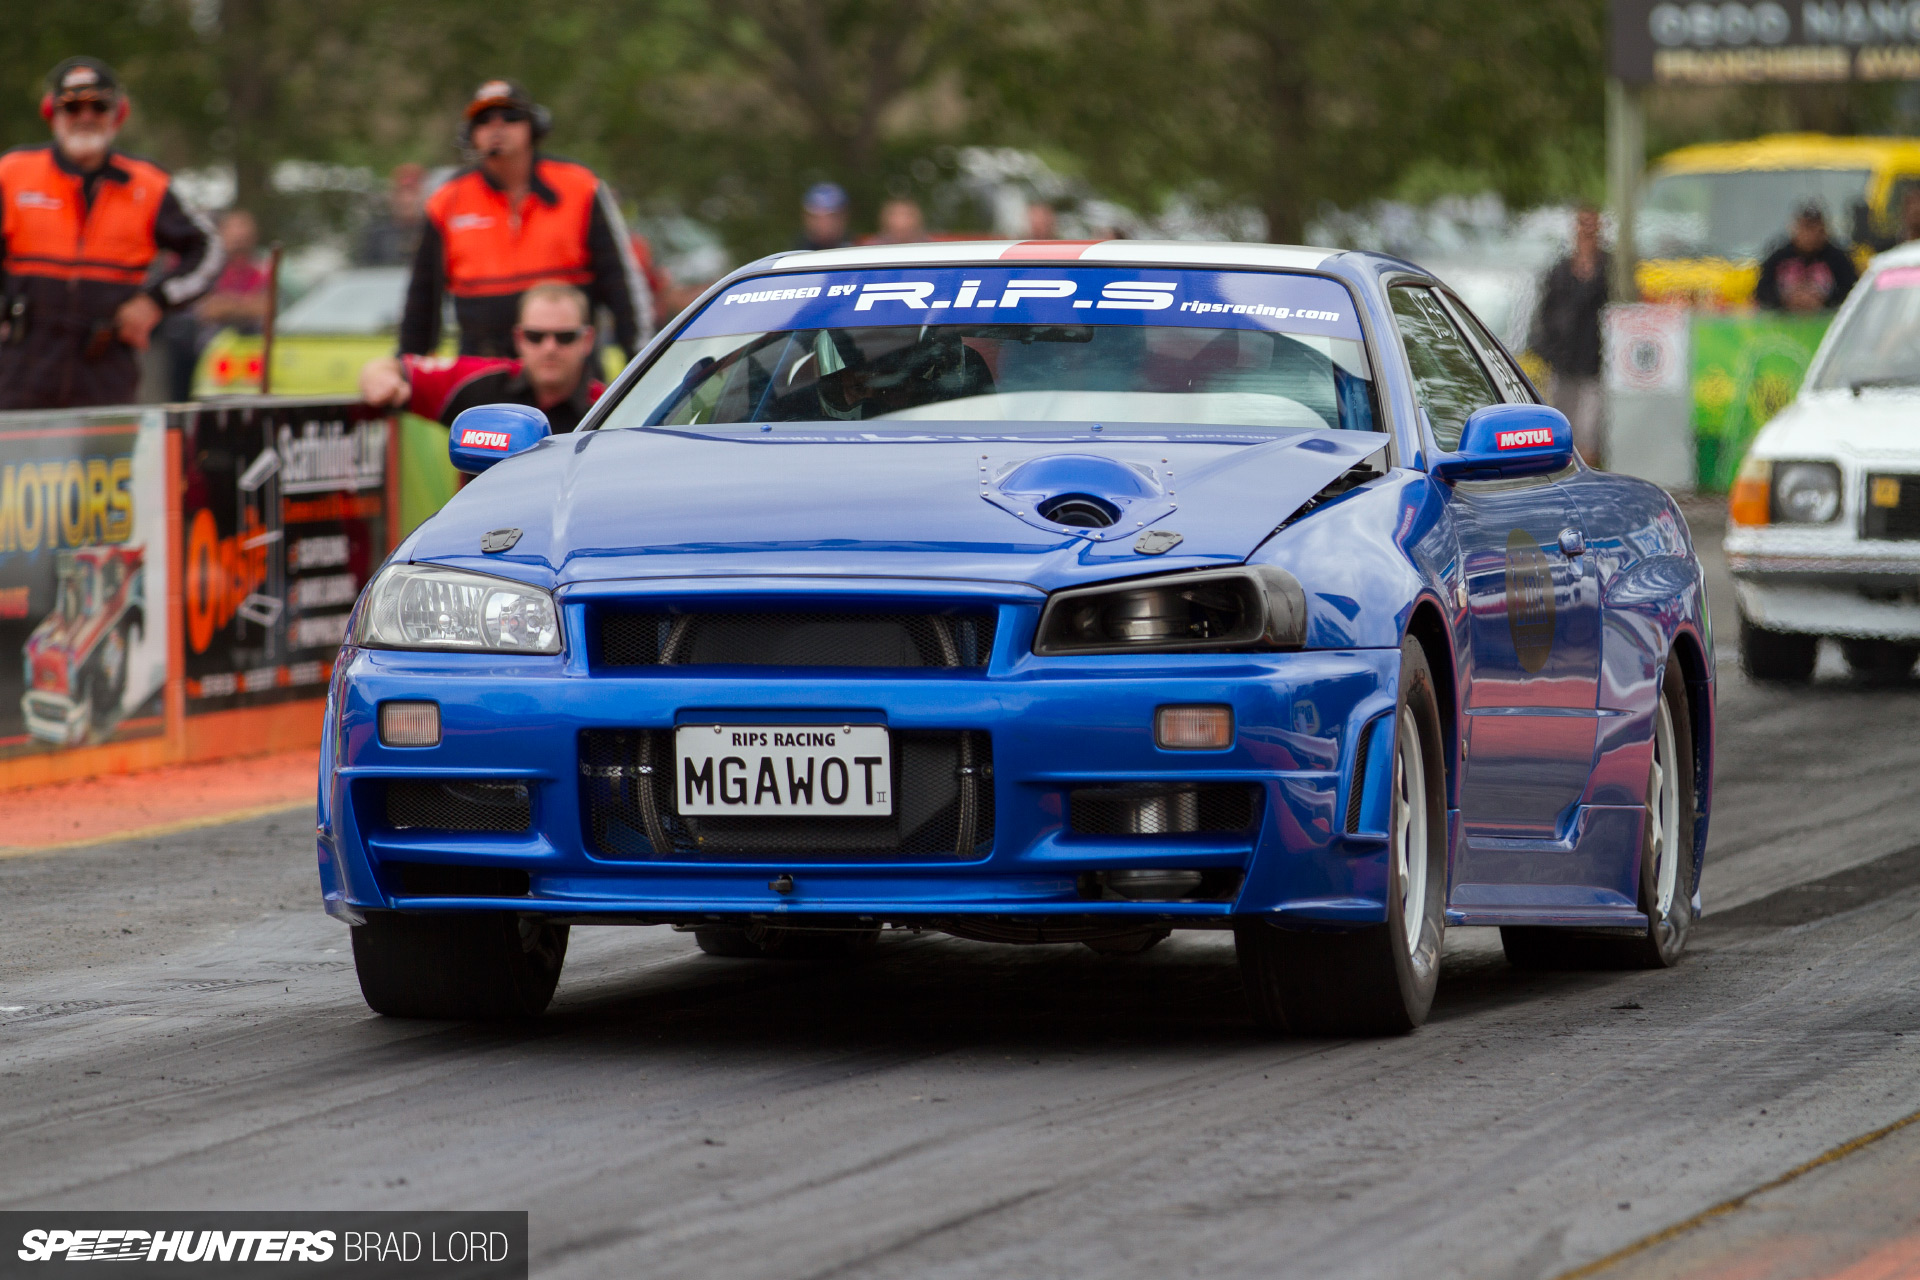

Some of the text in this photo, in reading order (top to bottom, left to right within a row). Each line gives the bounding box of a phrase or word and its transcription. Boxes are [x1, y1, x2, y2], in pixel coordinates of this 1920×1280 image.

[723, 287, 822, 306] POWERED
[827, 284, 858, 298] BY
[1180, 300, 1340, 322] ripsracing.com
[462, 431, 508, 448] MOTUL
[1501, 429, 1552, 447] MOTUL
[732, 733, 836, 747] RIPS RACING
[684, 756, 883, 805] MGAWOT
